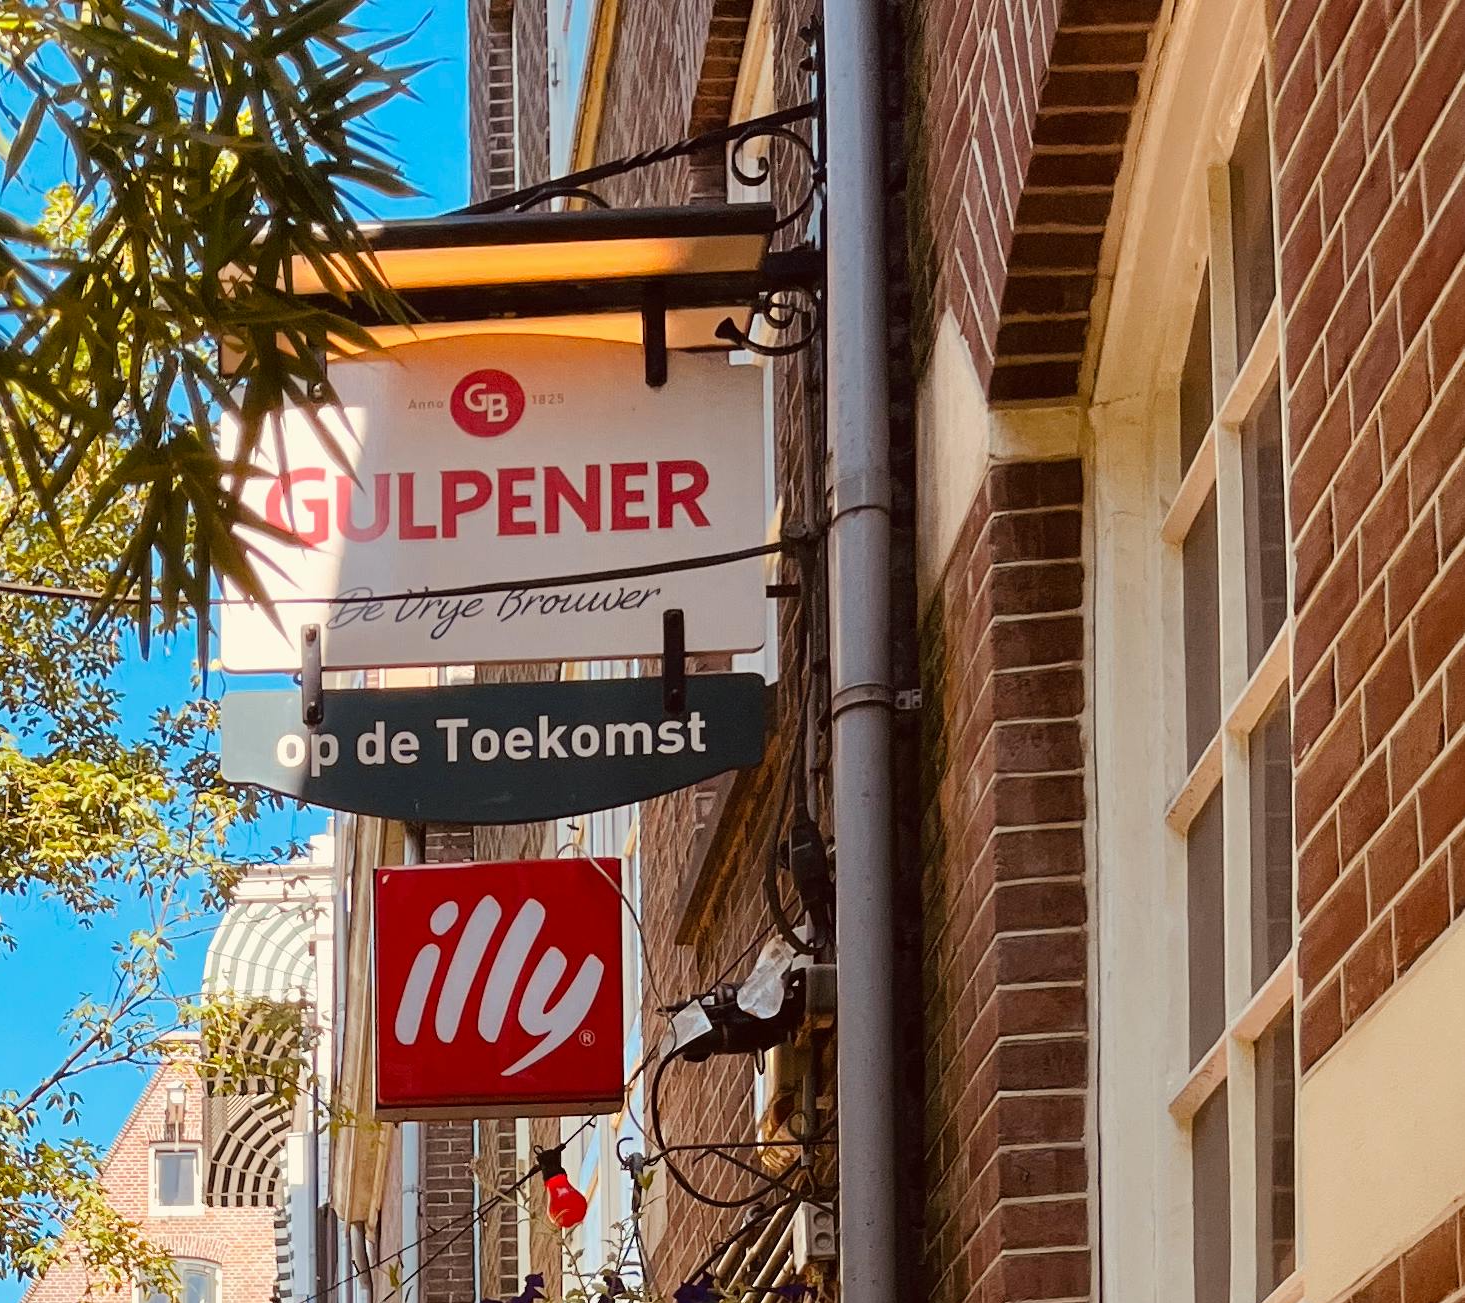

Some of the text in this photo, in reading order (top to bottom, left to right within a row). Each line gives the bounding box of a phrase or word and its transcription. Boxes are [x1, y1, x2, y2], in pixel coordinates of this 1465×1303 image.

[407, 382, 565, 423] Anno GB 1825
[265, 459, 712, 545] GULPENER
[326, 586, 386, 630] De
[496, 584, 662, 622] Brouwer
[276, 711, 707, 778] op de Toekomst
[395, 894, 605, 1077] illy
